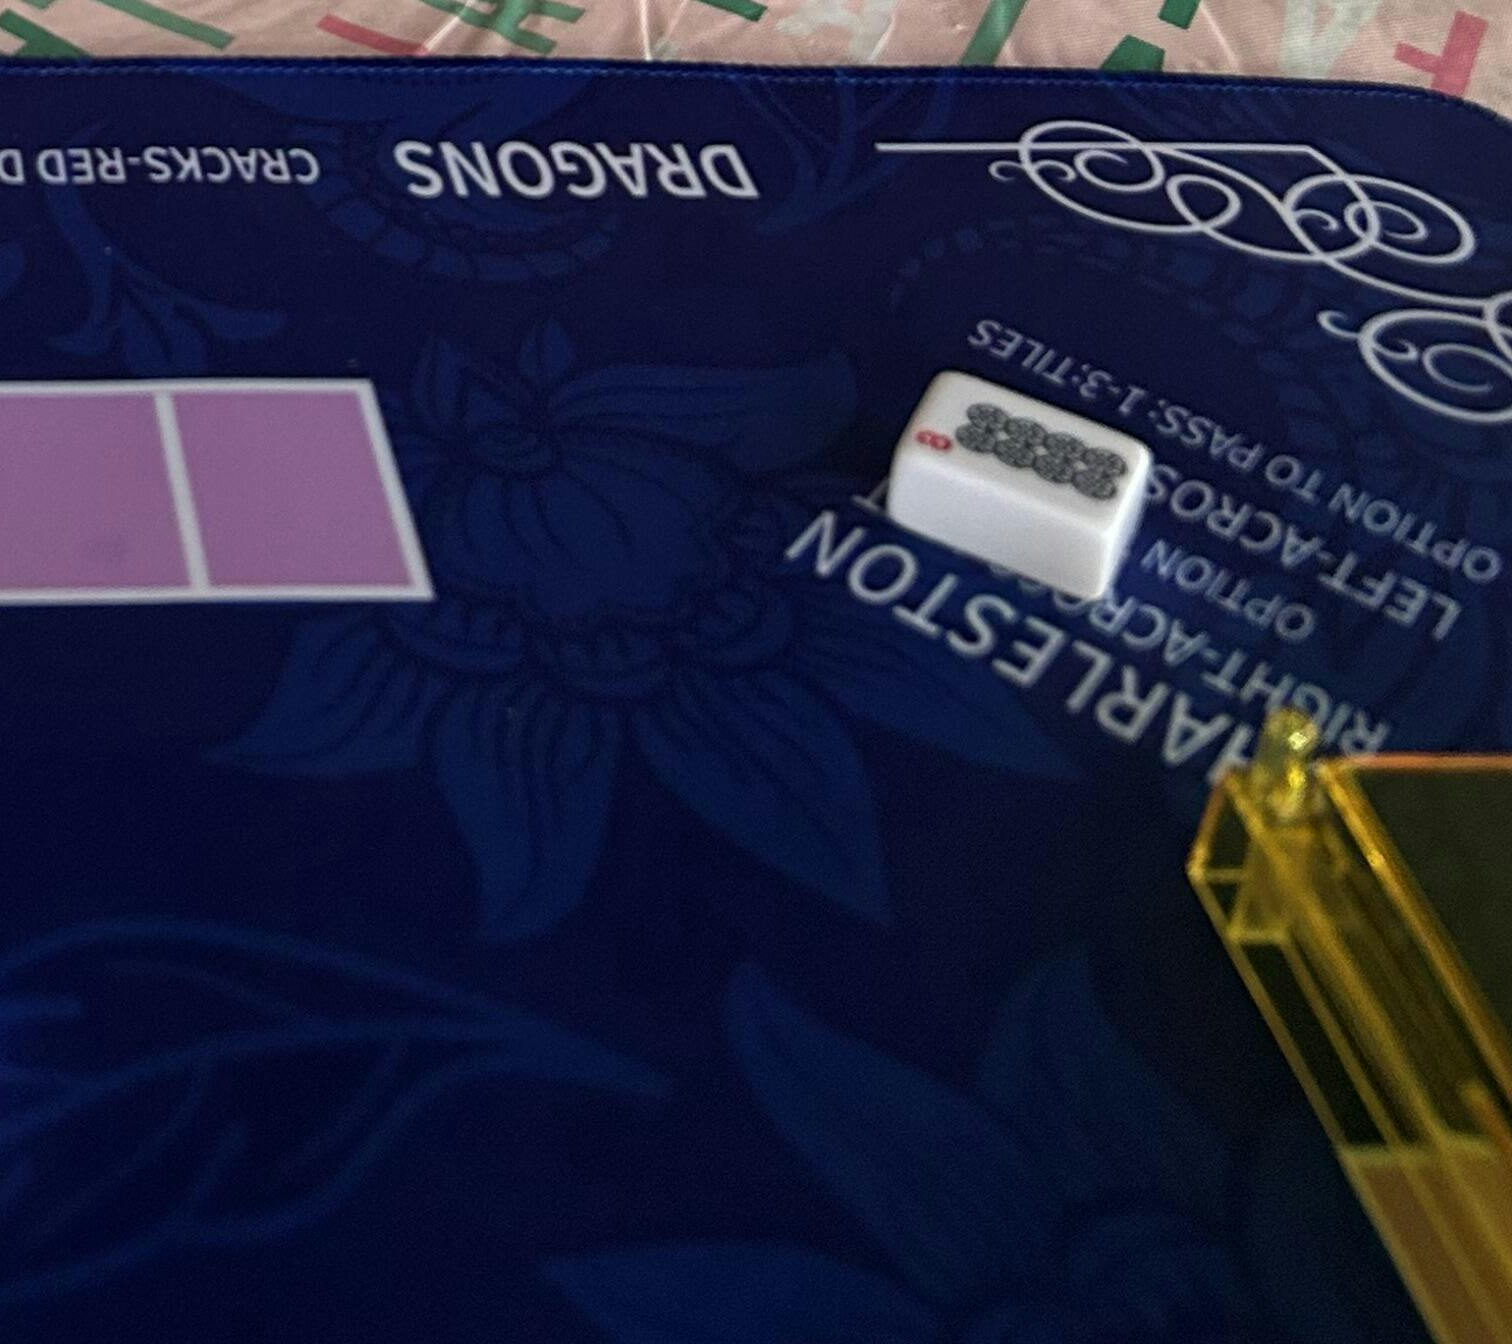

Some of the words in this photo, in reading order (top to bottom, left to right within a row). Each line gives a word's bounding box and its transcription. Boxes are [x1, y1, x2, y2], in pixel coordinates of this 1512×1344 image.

[37, 147, 320, 186] CRACKS-RED
[393, 140, 761, 200] DRAGONS
[1265, 453, 1320, 506] TO
[1328, 487, 1502, 583] OPTION
[1141, 538, 1317, 643] OPTION
[786, 511, 1253, 786] HARLESTON
